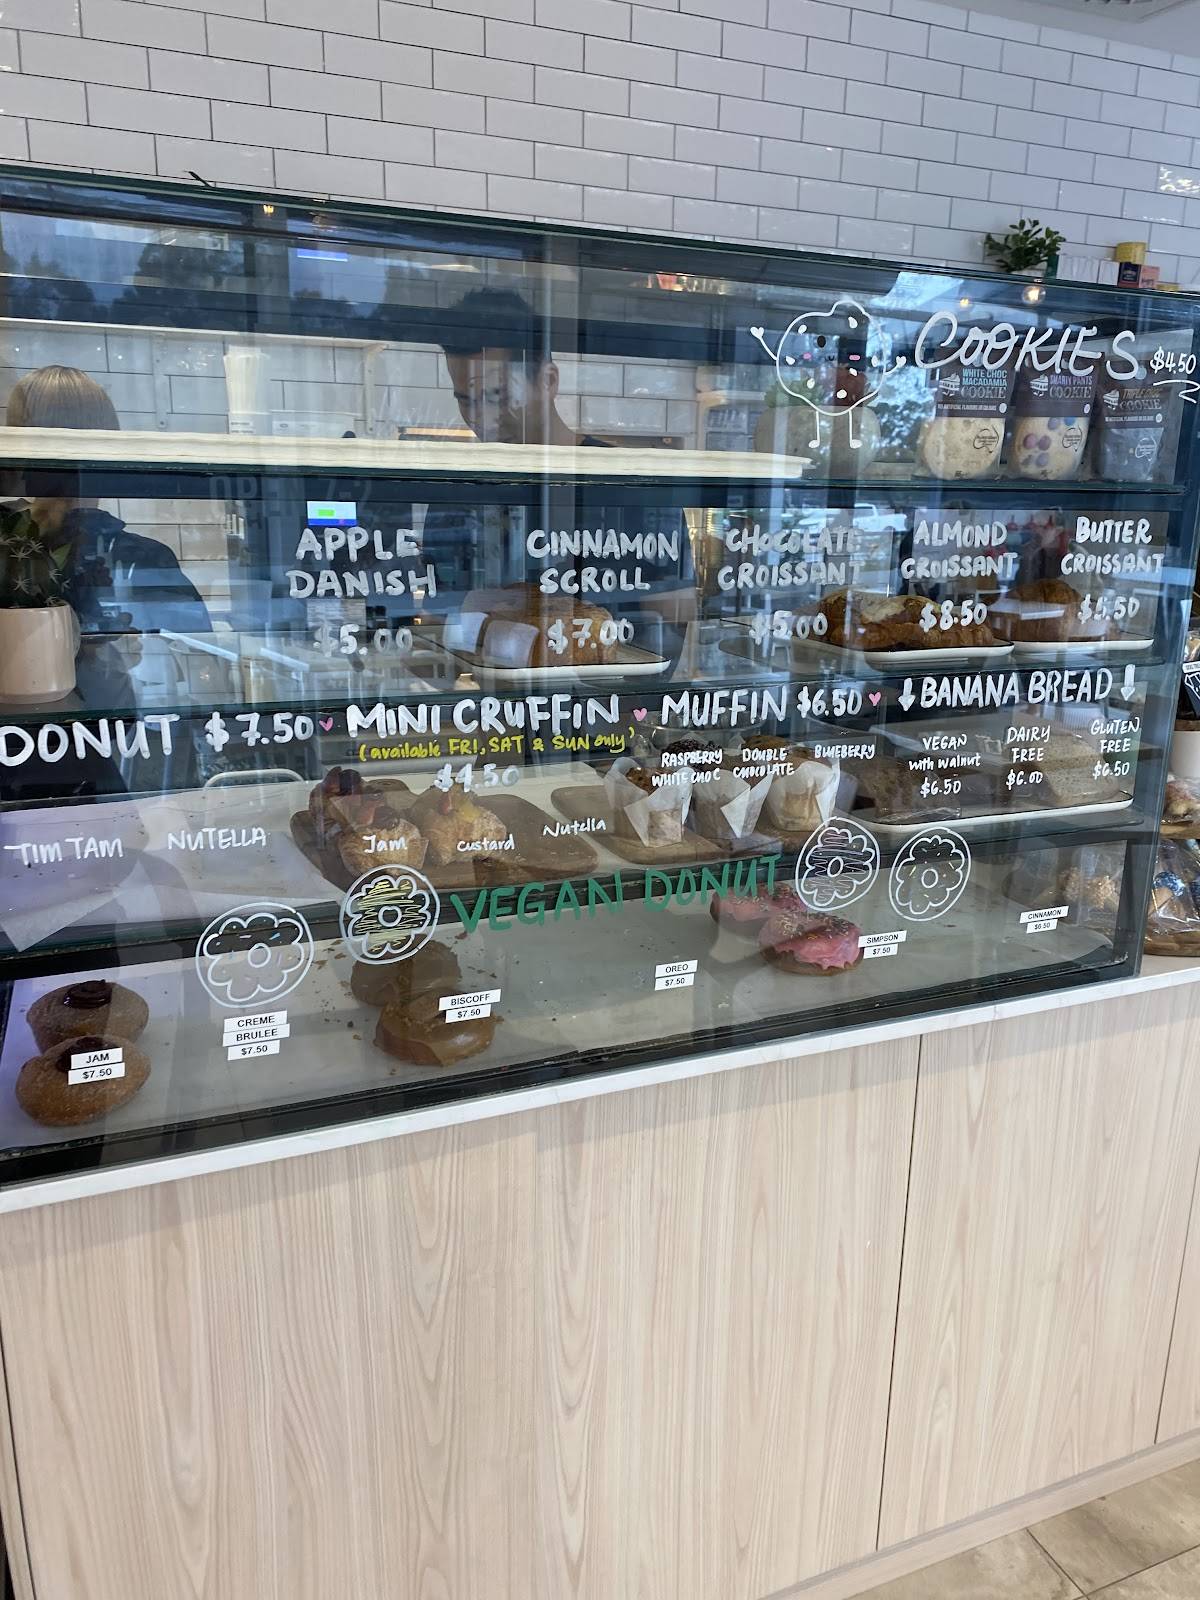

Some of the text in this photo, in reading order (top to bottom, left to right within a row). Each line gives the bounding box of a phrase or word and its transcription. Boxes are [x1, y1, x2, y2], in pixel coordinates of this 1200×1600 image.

[915, 311, 1197, 380] COOKIES $4.50
[962, 368, 1008, 378] WHITE CHOC
[962, 378, 1008, 387] MACADAMIA
[961, 386, 1007, 398] COOKIE
[1050, 386, 1092, 398] COOKIE
[725, 524, 866, 557] CHOCOLATE
[913, 519, 1008, 548] ALMOND
[1075, 516, 1153, 545] BUTTER
[296, 526, 422, 562] APPLE
[526, 528, 679, 562] CINNAMON
[901, 552, 1019, 579] CROISSANT
[1060, 553, 1165, 576] CROISSANT
[285, 563, 437, 599] DANISH
[539, 566, 651, 595] SCROLL
[718, 560, 866, 591] CROISSANT
[920, 599, 988, 633] $8.50
[1077, 593, 1141, 625] $5.50
[547, 618, 635, 654] $7.00
[749, 610, 828, 645] $5.00
[313, 624, 413, 657] $5.00
[920, 667, 1113, 709] BANANA BREAD
[346, 693, 621, 739] MINI CRUFFIN
[661, 685, 863, 728] MUFFIN $6.50
[1006, 724, 1051, 745] DAIRY
[1090, 716, 1140, 736] GLUTEN
[0, 711, 315, 767] DONUT $7.50
[489, 734, 525, 753] SAT
[532, 738, 545, 752] &
[551, 734, 590, 751] SUN
[922, 733, 968, 752] VEGAN
[1100, 739, 1131, 754] FREE
[661, 748, 723, 768] RASPBERRY
[742, 747, 789, 763] DOUBLE
[814, 743, 876, 760] BLUEBERRY
[1011, 747, 1045, 764] FREE
[732, 762, 796, 779] CHOCOLATE
[908, 755, 982, 772] with walnut
[1092, 760, 1130, 780] $6.50
[433, 763, 521, 793] $4.50
[651, 771, 689, 788] WHITE
[919, 777, 962, 799] $6.50
[1005, 768, 1043, 791] $6.00
[542, 817, 607, 838] Nutella
[167, 827, 268, 851] NUTELLA
[362, 835, 408, 854] Jam
[4, 836, 125, 866] TIM TAM
[450, 853, 783, 934] VEGAN DONUT
[1027, 908, 1062, 920] CINNAMON
[866, 933, 899, 944] SIMPSON
[665, 963, 689, 973] OREO
[450, 993, 491, 1006] BISCOFF
[237, 1015, 276, 1028] CREME
[457, 1008, 481, 1019] $7.50
[235, 1028, 279, 1042] BRULEE
[85, 1052, 110, 1064] JAM
[241, 1044, 268, 1057] $7.50
[82, 1067, 112, 1080] $7.50
